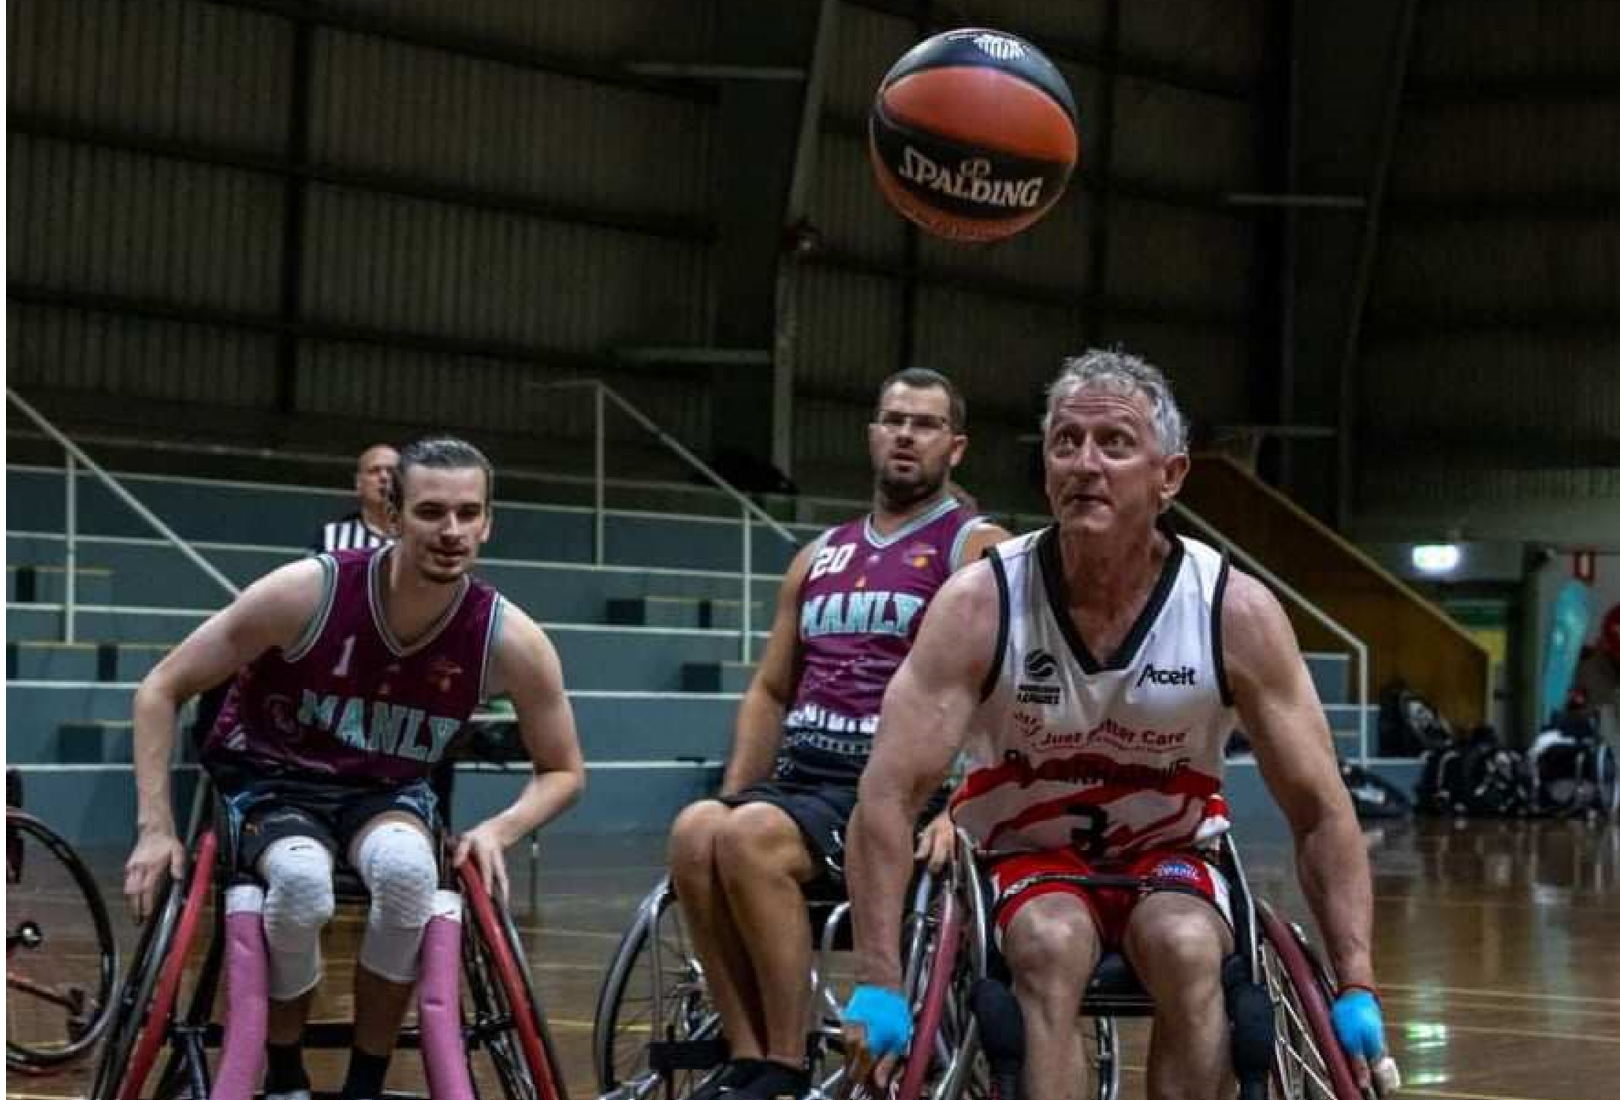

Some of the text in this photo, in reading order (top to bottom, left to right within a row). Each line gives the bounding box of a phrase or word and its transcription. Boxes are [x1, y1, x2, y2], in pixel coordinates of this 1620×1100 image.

[899, 144, 1043, 208] SPALDING
[809, 543, 857, 581] 20
[800, 591, 926, 641] MANLY
[332, 635, 356, 676] 1
[1135, 664, 1196, 689] Aceit
[298, 688, 461, 763] MANLY
[1041, 732, 1082, 746] Just
[1142, 731, 1188, 746] Care
[1066, 802, 1107, 861] 3
